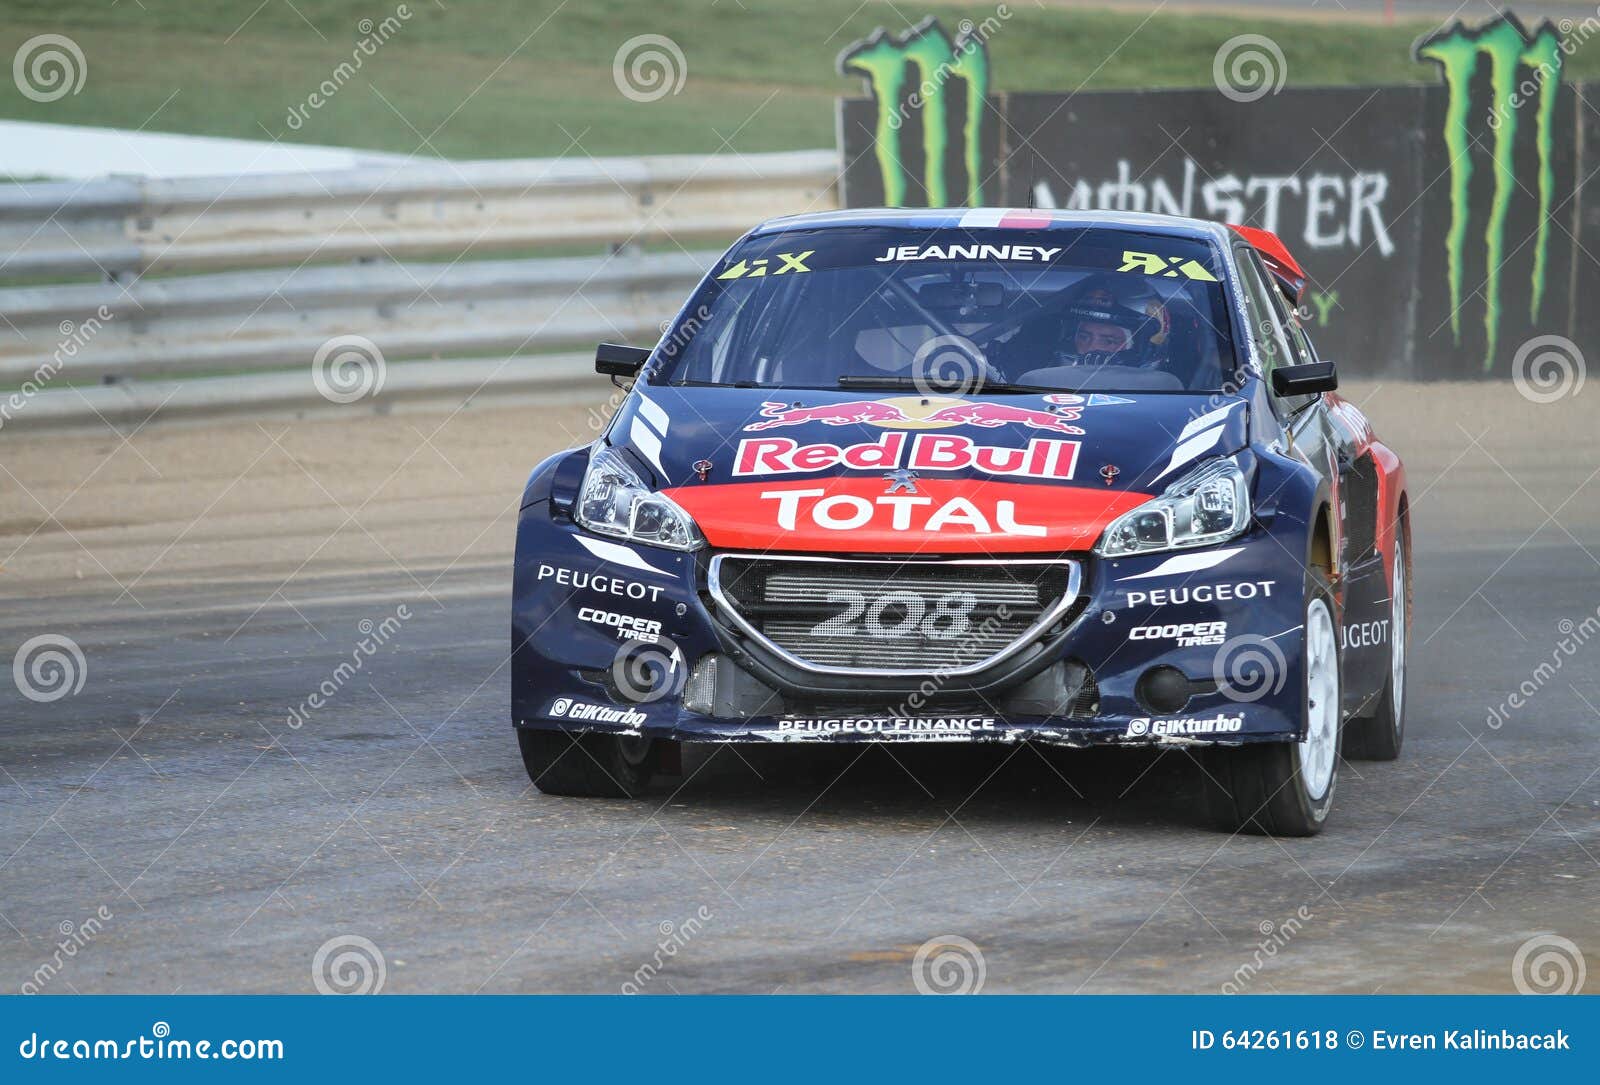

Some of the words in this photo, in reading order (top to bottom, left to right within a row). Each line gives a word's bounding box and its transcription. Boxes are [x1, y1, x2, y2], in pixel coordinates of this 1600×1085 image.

[875, 244, 1062, 262] JEANNEY
[732, 432, 906, 477] Red
[908, 433, 1082, 480] Bull
[760, 488, 1047, 537] TOTAL
[537, 564, 665, 602] PEUGEOT
[1127, 581, 1276, 608] PEUGEOT
[577, 607, 662, 634] COOPER
[810, 590, 977, 639] 208
[617, 627, 660, 643] TIRES
[1128, 621, 1227, 640] COOPER
[1176, 635, 1226, 647] TIRES
[779, 719, 886, 732] PEUGEOT
[894, 718, 995, 731] FINANCE
